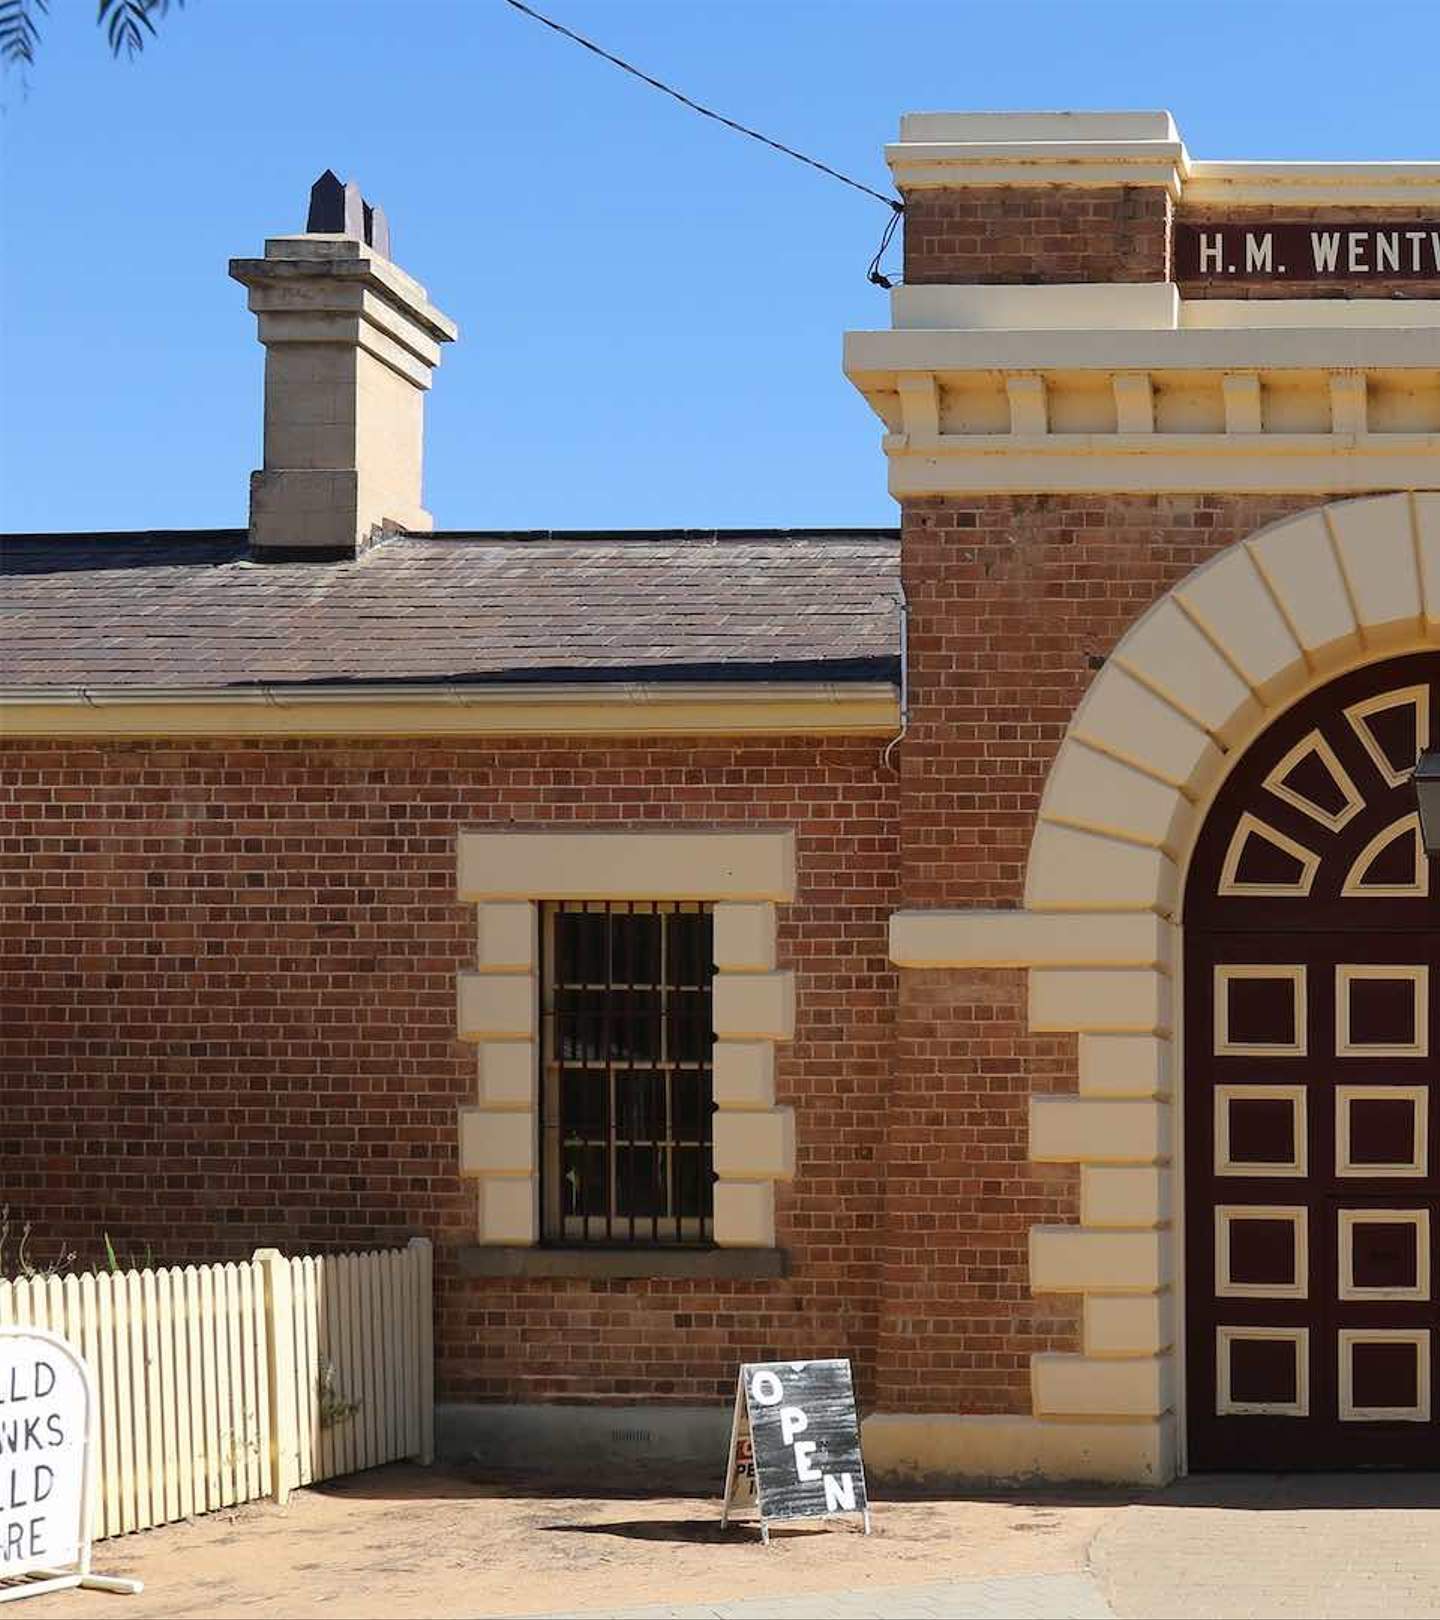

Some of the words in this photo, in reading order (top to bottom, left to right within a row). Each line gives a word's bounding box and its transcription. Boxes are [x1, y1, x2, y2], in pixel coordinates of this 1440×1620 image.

[1199, 232, 1286, 273] H.M.
[0, 1361, 56, 1404] LD
[751, 1370, 858, 1512] OPEN
[0, 1464, 54, 1511] LD
[0, 1516, 47, 1562] RE
